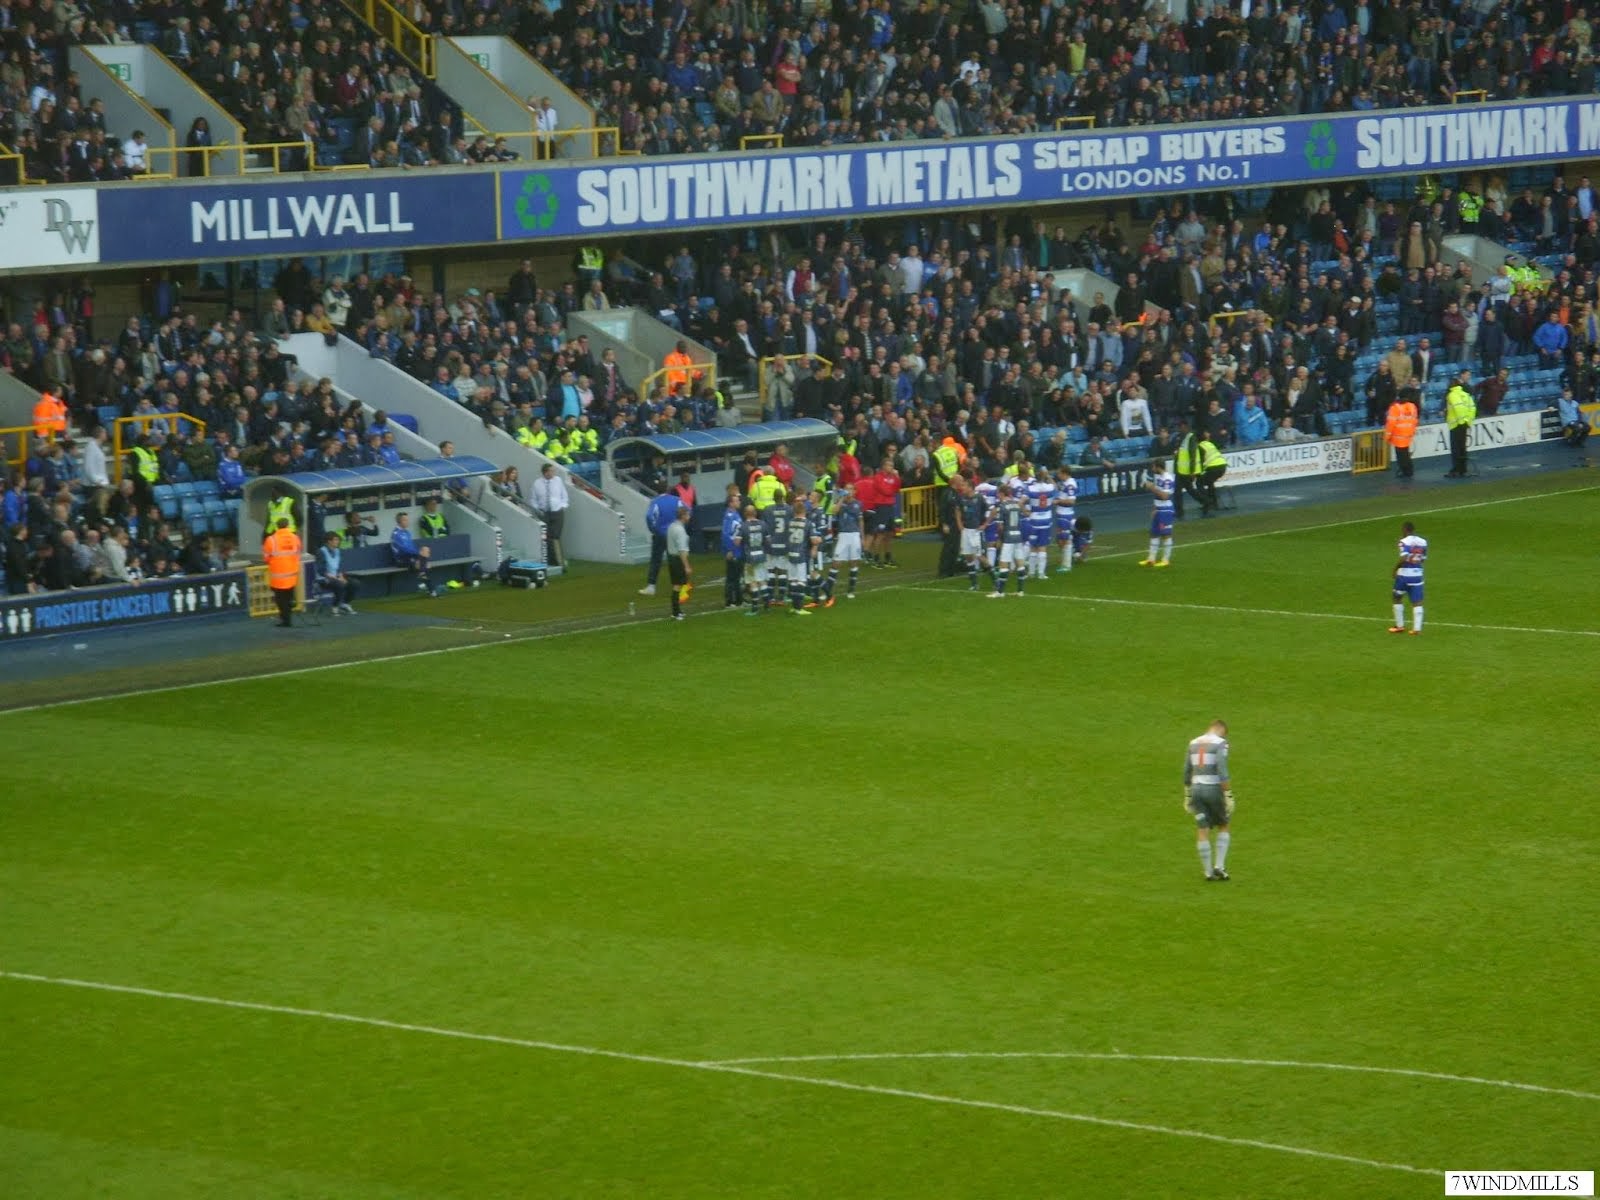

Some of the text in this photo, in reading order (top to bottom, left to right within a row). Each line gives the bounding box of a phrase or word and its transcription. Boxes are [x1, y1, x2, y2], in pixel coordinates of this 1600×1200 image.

[1034, 126, 1286, 170] SCRAP BUYERS
[1357, 105, 1568, 168] SOUTHWARK
[577, 143, 1022, 226] SOUTHWARK METALS
[1062, 161, 1251, 192] LONDONS No.1
[192, 192, 414, 243] MILLWALL
[1323, 440, 1351, 452] 0208
[1435, 420, 1505, 452] ABINS
[1261, 445, 1320, 464] LIMITED
[1324, 459, 1351, 470] 4960
[1327, 450, 1347, 461] 692
[36, 592, 170, 628] PROSTATE CANCER UK
